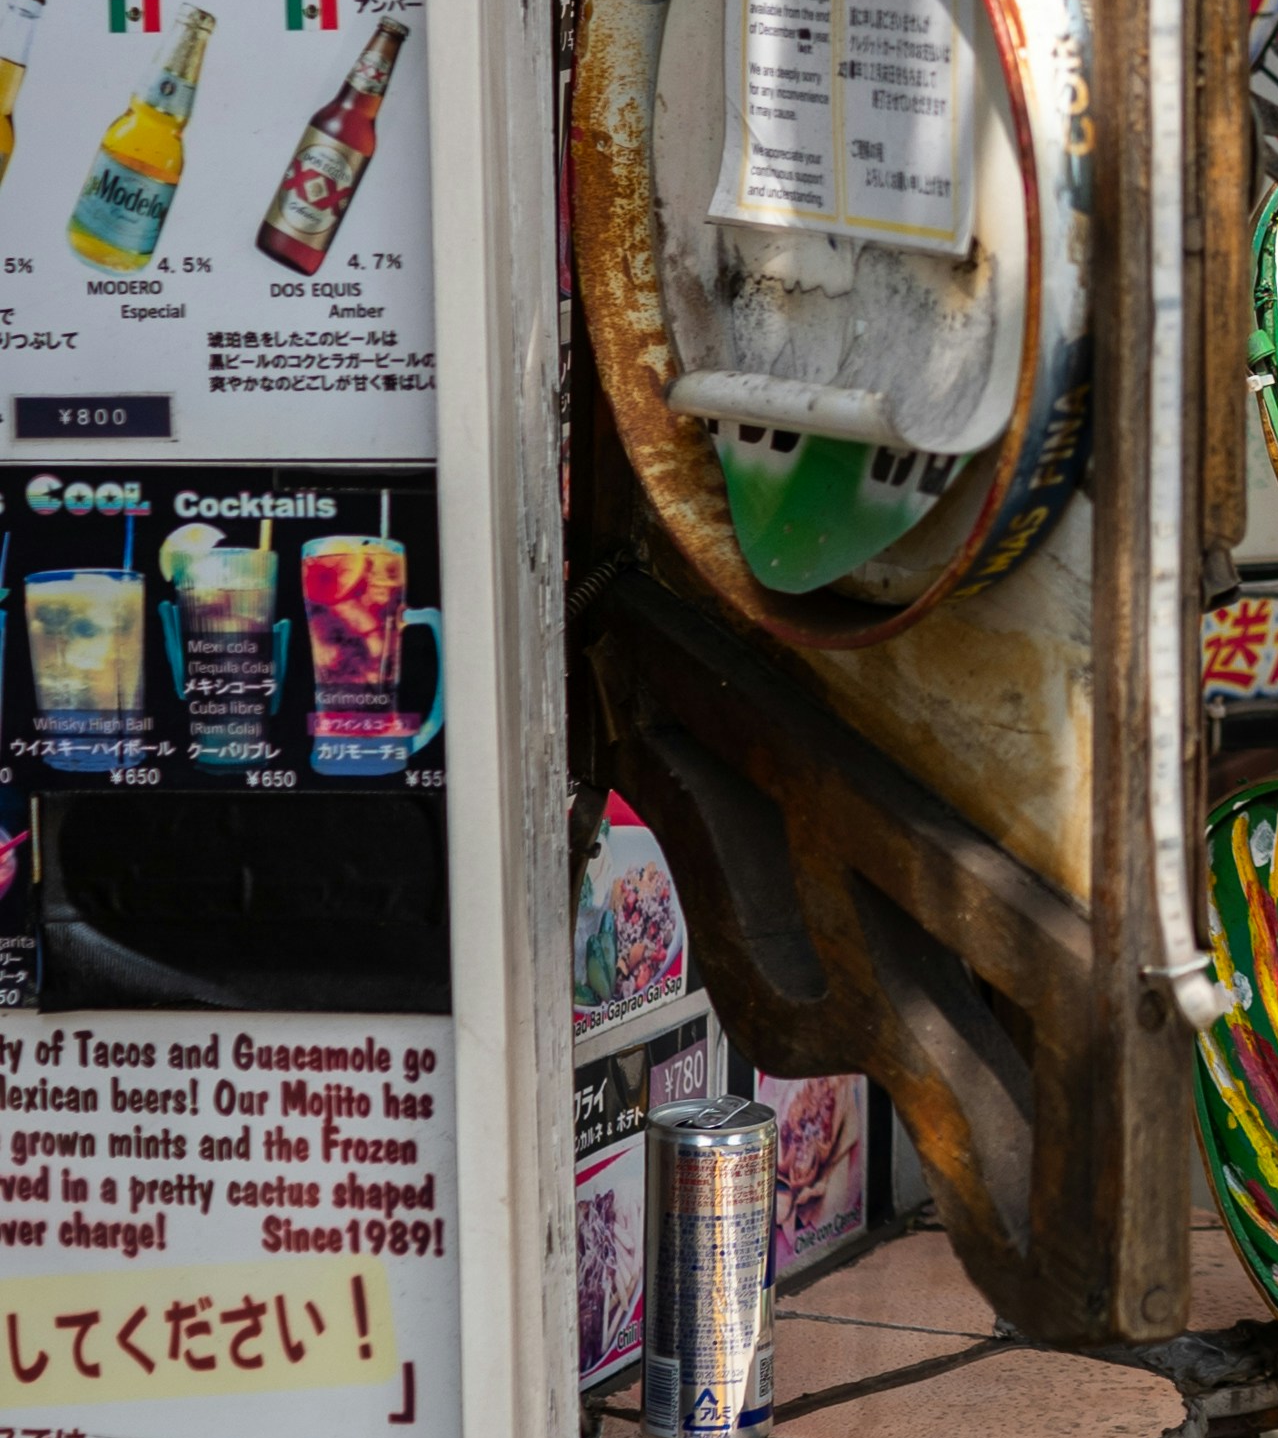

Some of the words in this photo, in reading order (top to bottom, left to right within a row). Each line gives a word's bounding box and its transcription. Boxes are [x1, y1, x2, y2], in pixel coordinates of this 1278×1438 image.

[98, 168, 165, 220] Modelo
[87, 280, 162, 295] MODERO
[270, 282, 305, 298] DOS
[311, 282, 363, 299] EQUIS
[121, 303, 187, 322] Especial
[328, 303, 386, 319] Amber
[207, 330, 398, 350] 琥珀色をしたこのビールは
[58, 408, 128, 426] ¥800
[174, 489, 337, 519] Cocktails
[187, 640, 224, 654] Mexi
[226, 640, 258, 654] cola
[187, 661, 239, 675] (Tequila
[241, 661, 277, 675] Cola)
[183, 678, 279, 696] メキシコーラ
[189, 700, 227, 715] Cuba
[229, 700, 264, 715] libre
[33, 718, 86, 734] Whisky
[88, 717, 122, 734] High
[125, 718, 154, 732] Ball
[189, 722, 224, 736] (Rum
[10, 738, 177, 757] ウイスキーハイボール
[316, 743, 408, 761] カリモーチョ
[109, 767, 161, 785] ¥650
[245, 769, 297, 788] ¥650
[404, 769, 446, 787] ¥55
[589, 1005, 605, 1030] Bai
[607, 994, 644, 1022] Gaprao
[646, 983, 662, 1005] Gai
[664, 975, 682, 997] Sap
[35, 1029, 64, 1067] of
[73, 1030, 156, 1069] Tacos
[168, 1032, 219, 1070] and
[232, 1032, 391, 1073] Guacamole
[403, 1047, 437, 1084] go
[111, 1076, 199, 1117] beers!
[213, 1078, 269, 1117] Our
[280, 1078, 372, 1125] Mojito
[382, 1081, 434, 1121] has
[11, 1130, 96, 1166] grown
[108, 1125, 187, 1161] mints
[199, 1124, 252, 1162] and
[263, 1125, 310, 1164] the
[321, 1124, 418, 1166] Frozen
[61, 1167, 89, 1203] in
[100, 1176, 118, 1205] a
[129, 1173, 215, 1216] pretty
[226, 1175, 321, 1209] cactus
[331, 1171, 435, 1220] shaped
[58, 1210, 167, 1259] charge!
[699, 1406, 731, 1422] アルミ
